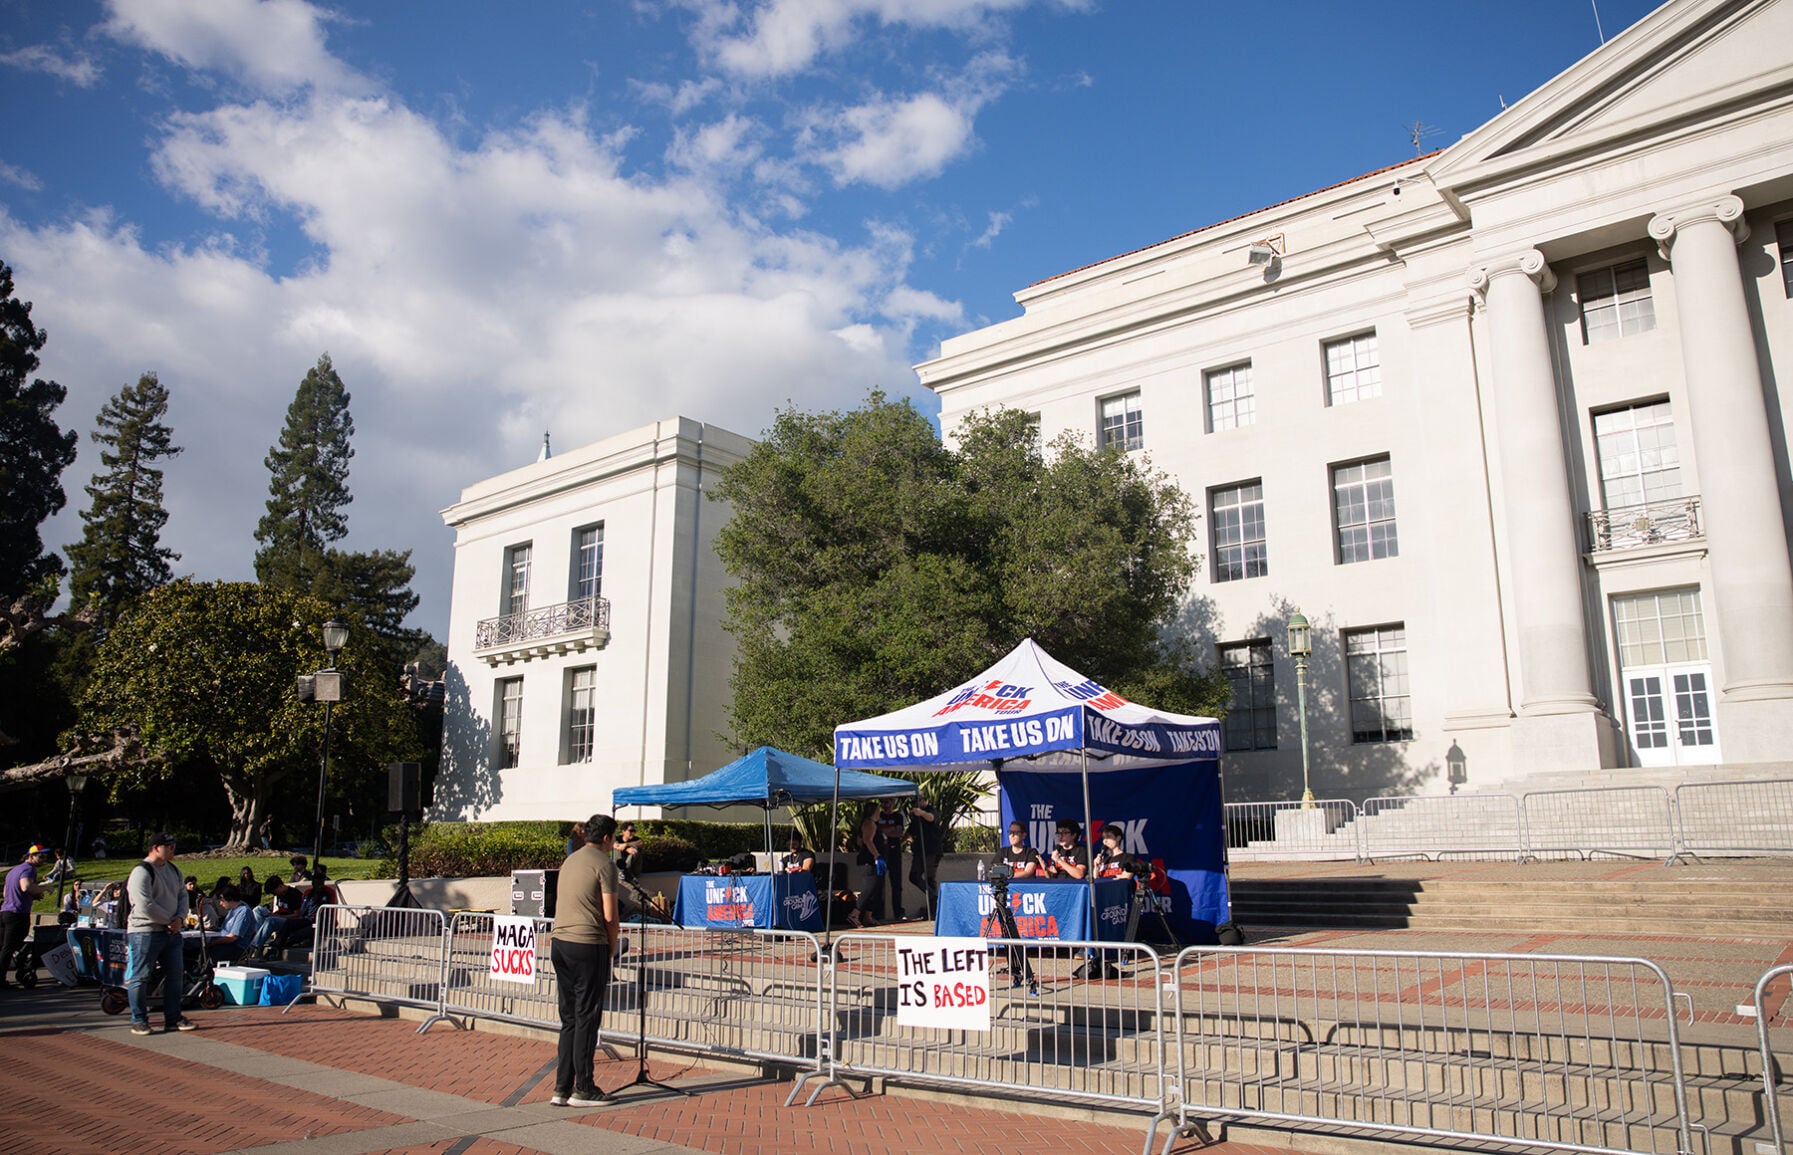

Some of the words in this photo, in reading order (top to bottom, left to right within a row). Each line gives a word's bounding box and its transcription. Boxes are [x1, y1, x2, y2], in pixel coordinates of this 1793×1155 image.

[931, 693, 1032, 718] AMERICA
[960, 724, 1010, 753] TAKE
[1010, 720, 1043, 747] US
[1045, 714, 1074, 742] ON
[1087, 715, 1123, 745] TAKE
[1121, 729, 1144, 749] US
[1166, 731, 1195, 753] TAKE
[1206, 729, 1221, 751] ON
[840, 736, 884, 760] TAKE
[883, 735, 908, 759] US
[912, 732, 938, 757] ON
[1030, 804, 1054, 820] THE
[705, 886, 748, 904] UNFCK
[978, 884, 993, 894] THE
[706, 903, 754, 921] AMERICA
[497, 924, 535, 948] MAGA
[979, 915, 1060, 938] AMRICA
[492, 948, 533, 976] SUCKS
[898, 948, 936, 976] THE
[941, 948, 987, 973] LEFT
[899, 980, 927, 1007] IS
[934, 982, 986, 1008] BASED
